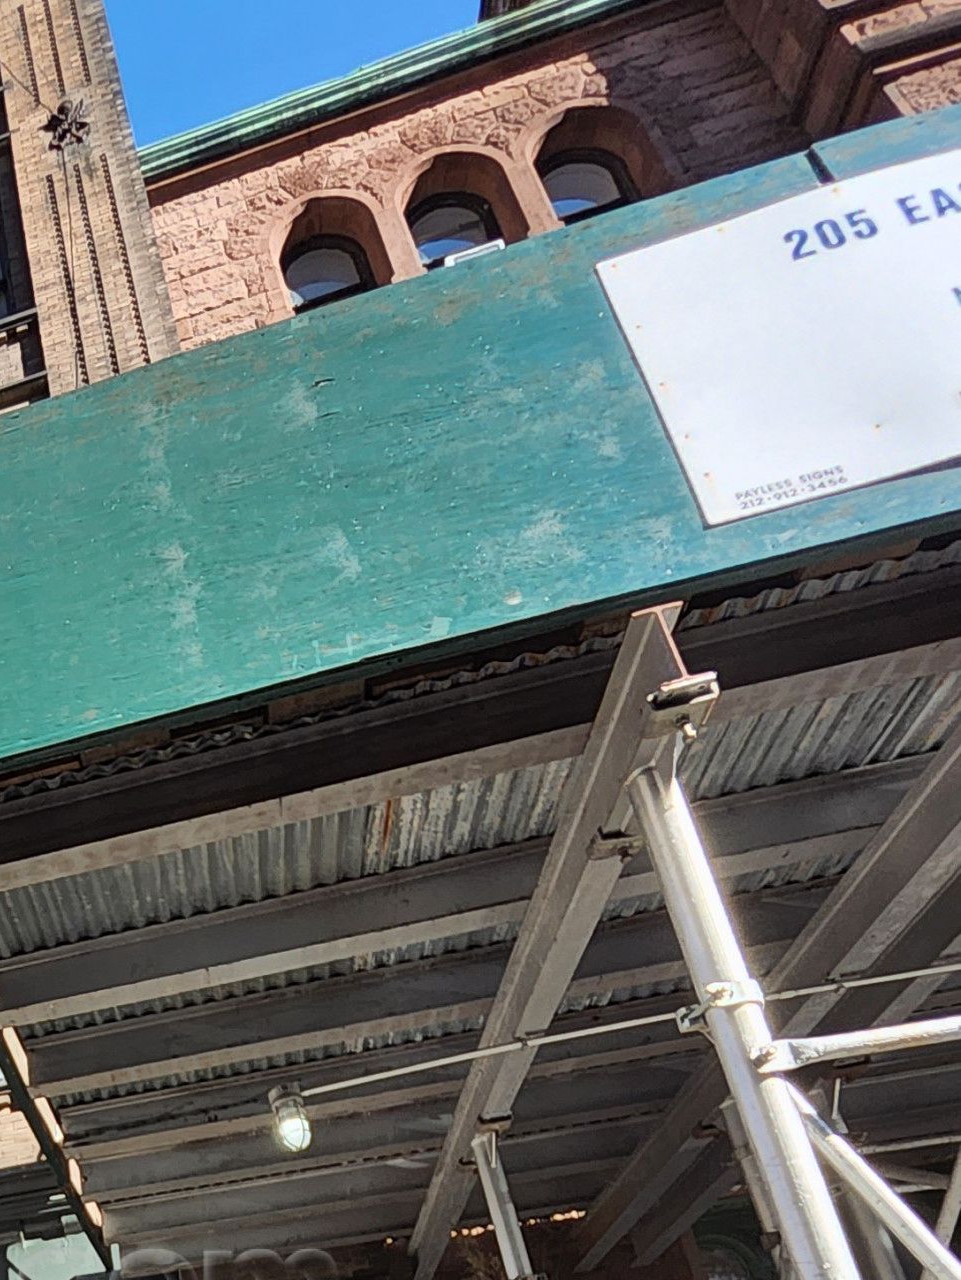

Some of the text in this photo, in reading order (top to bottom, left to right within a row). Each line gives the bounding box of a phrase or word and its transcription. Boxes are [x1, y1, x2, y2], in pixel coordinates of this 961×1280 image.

[783, 182, 961, 261] 205 EA
[735, 465, 844, 500] PAYLESS SIGNS
